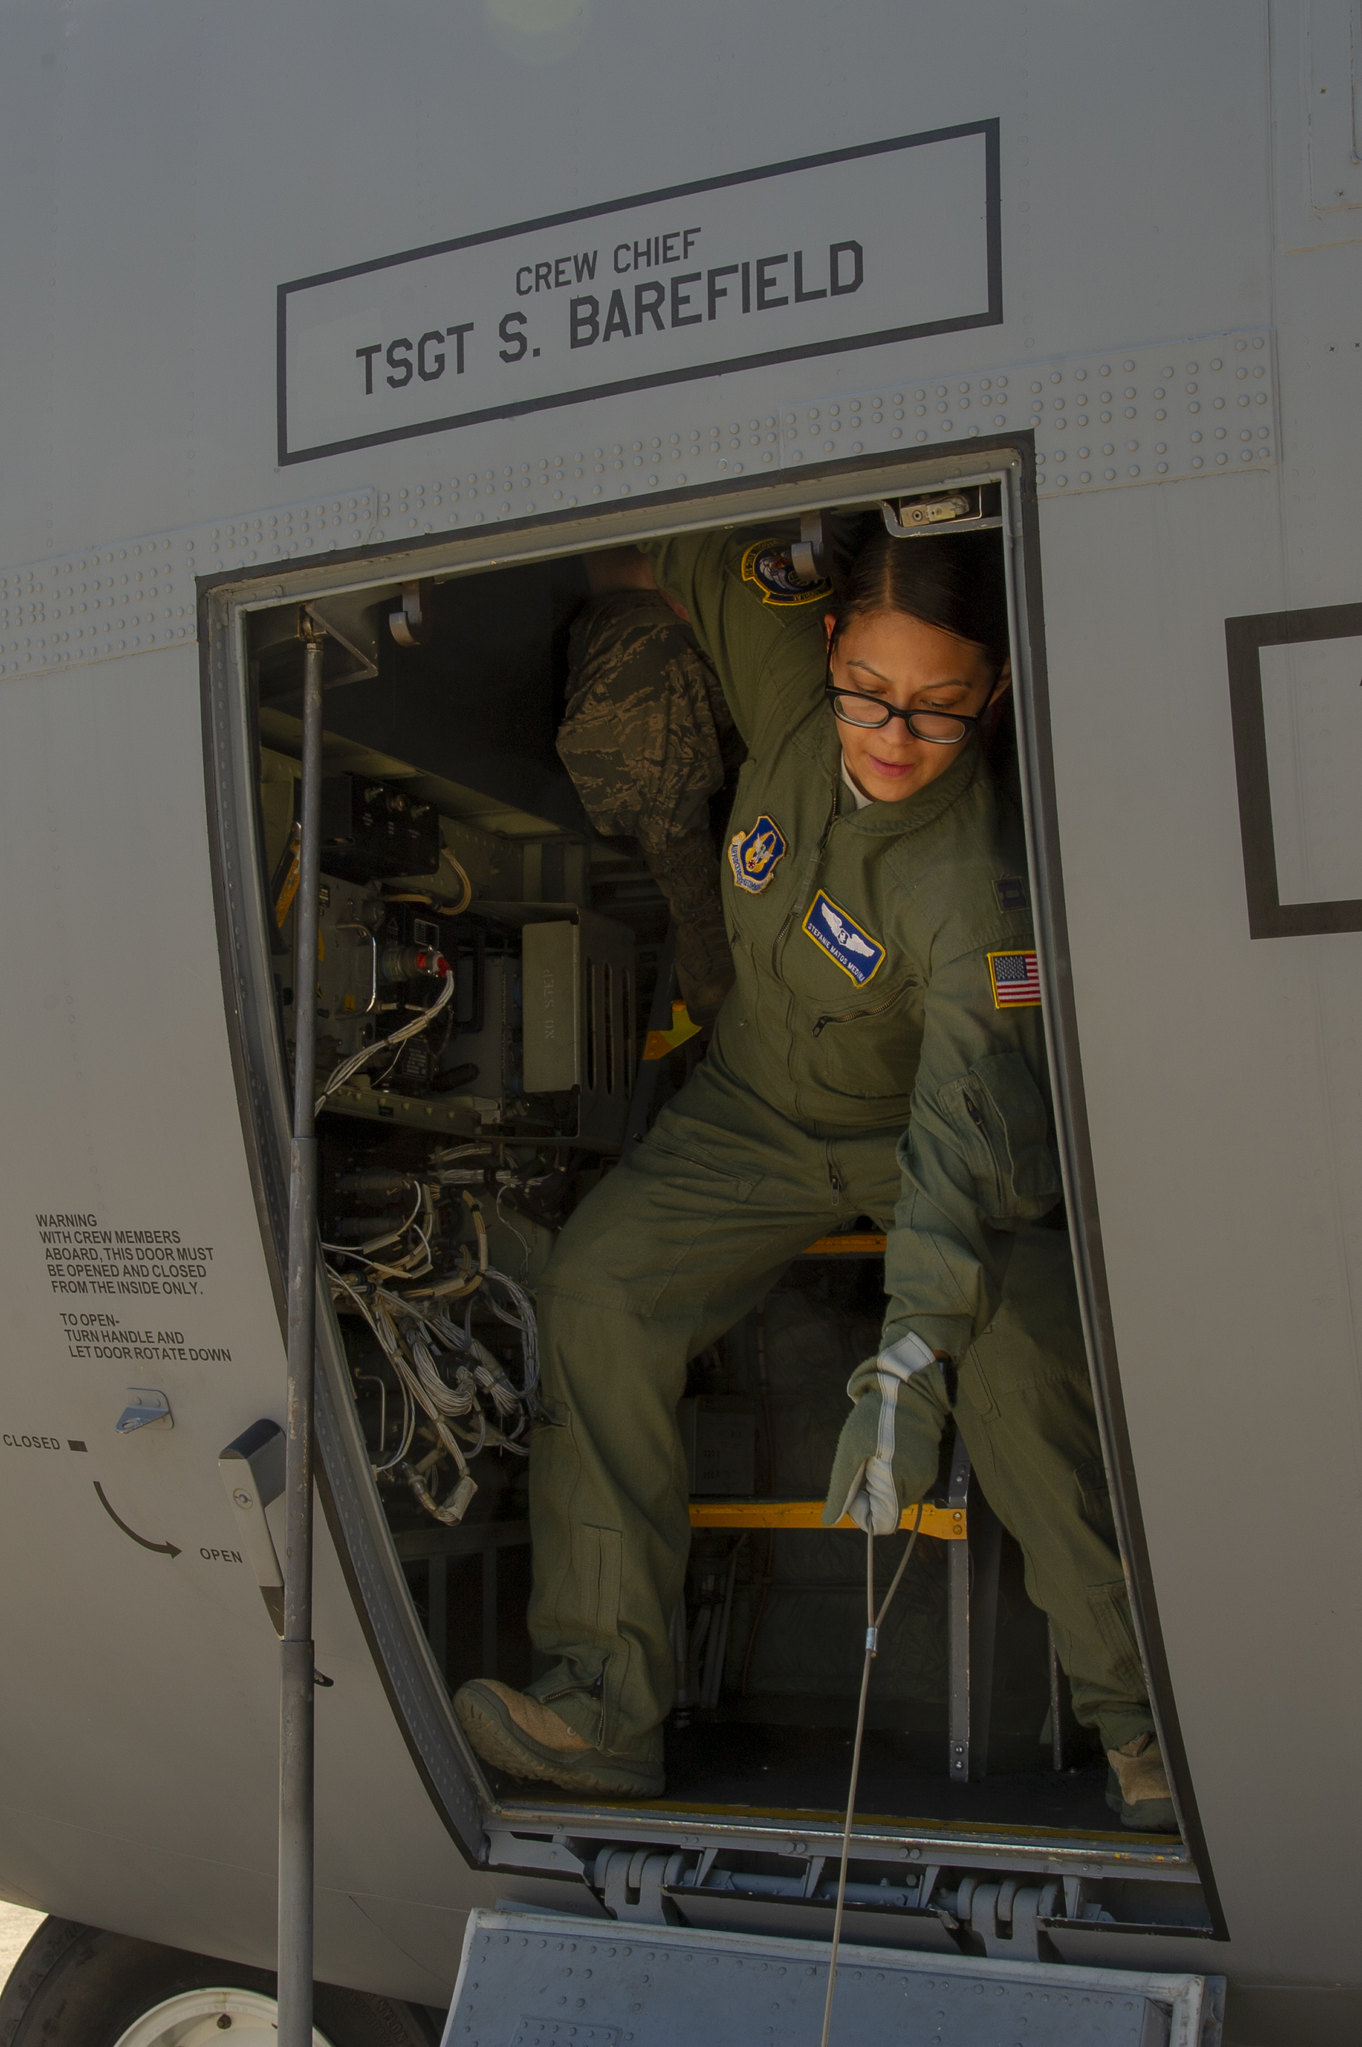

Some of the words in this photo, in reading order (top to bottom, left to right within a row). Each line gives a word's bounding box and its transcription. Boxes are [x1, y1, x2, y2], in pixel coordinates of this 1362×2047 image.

[516, 250, 598, 296] CREW
[614, 227, 701, 274] CHIEF
[356, 322, 474, 395] TSGT
[499, 311, 540, 363] S.
[569, 240, 864, 350] BAREFIELD
[807, 922, 832, 949] STEFANIE
[36, 1214, 97, 1227] WARNING
[40, 1231, 72, 1243] WITH
[74, 1231, 112, 1243] CREW
[115, 1231, 180, 1243] MEMBERS
[45, 1247, 103, 1262] ABOARD,
[103, 1248, 133, 1260] THIS
[135, 1248, 175, 1260] DOOR
[176, 1248, 213, 1260] MUST
[47, 1264, 65, 1276] BE
[67, 1264, 119, 1277] OPENED
[123, 1265, 149, 1277] AND
[152, 1265, 206, 1277] CLOSED
[51, 1281, 88, 1293] FROM
[89, 1281, 116, 1293] THE
[117, 1281, 160, 1294] INSIDE
[163, 1282, 203, 1294] ONLY.
[60, 1313, 77, 1325] TO
[64, 1329, 99, 1342] TURN
[101, 1331, 155, 1343] HANDLE
[158, 1332, 184, 1344] AND
[69, 1346, 91, 1358] LET
[94, 1346, 132, 1359] DOOR
[134, 1347, 187, 1360] ROTATE
[189, 1349, 231, 1361] DOWN
[3, 1434, 60, 1449] CLOSED
[200, 1548, 242, 1563] OPEN
